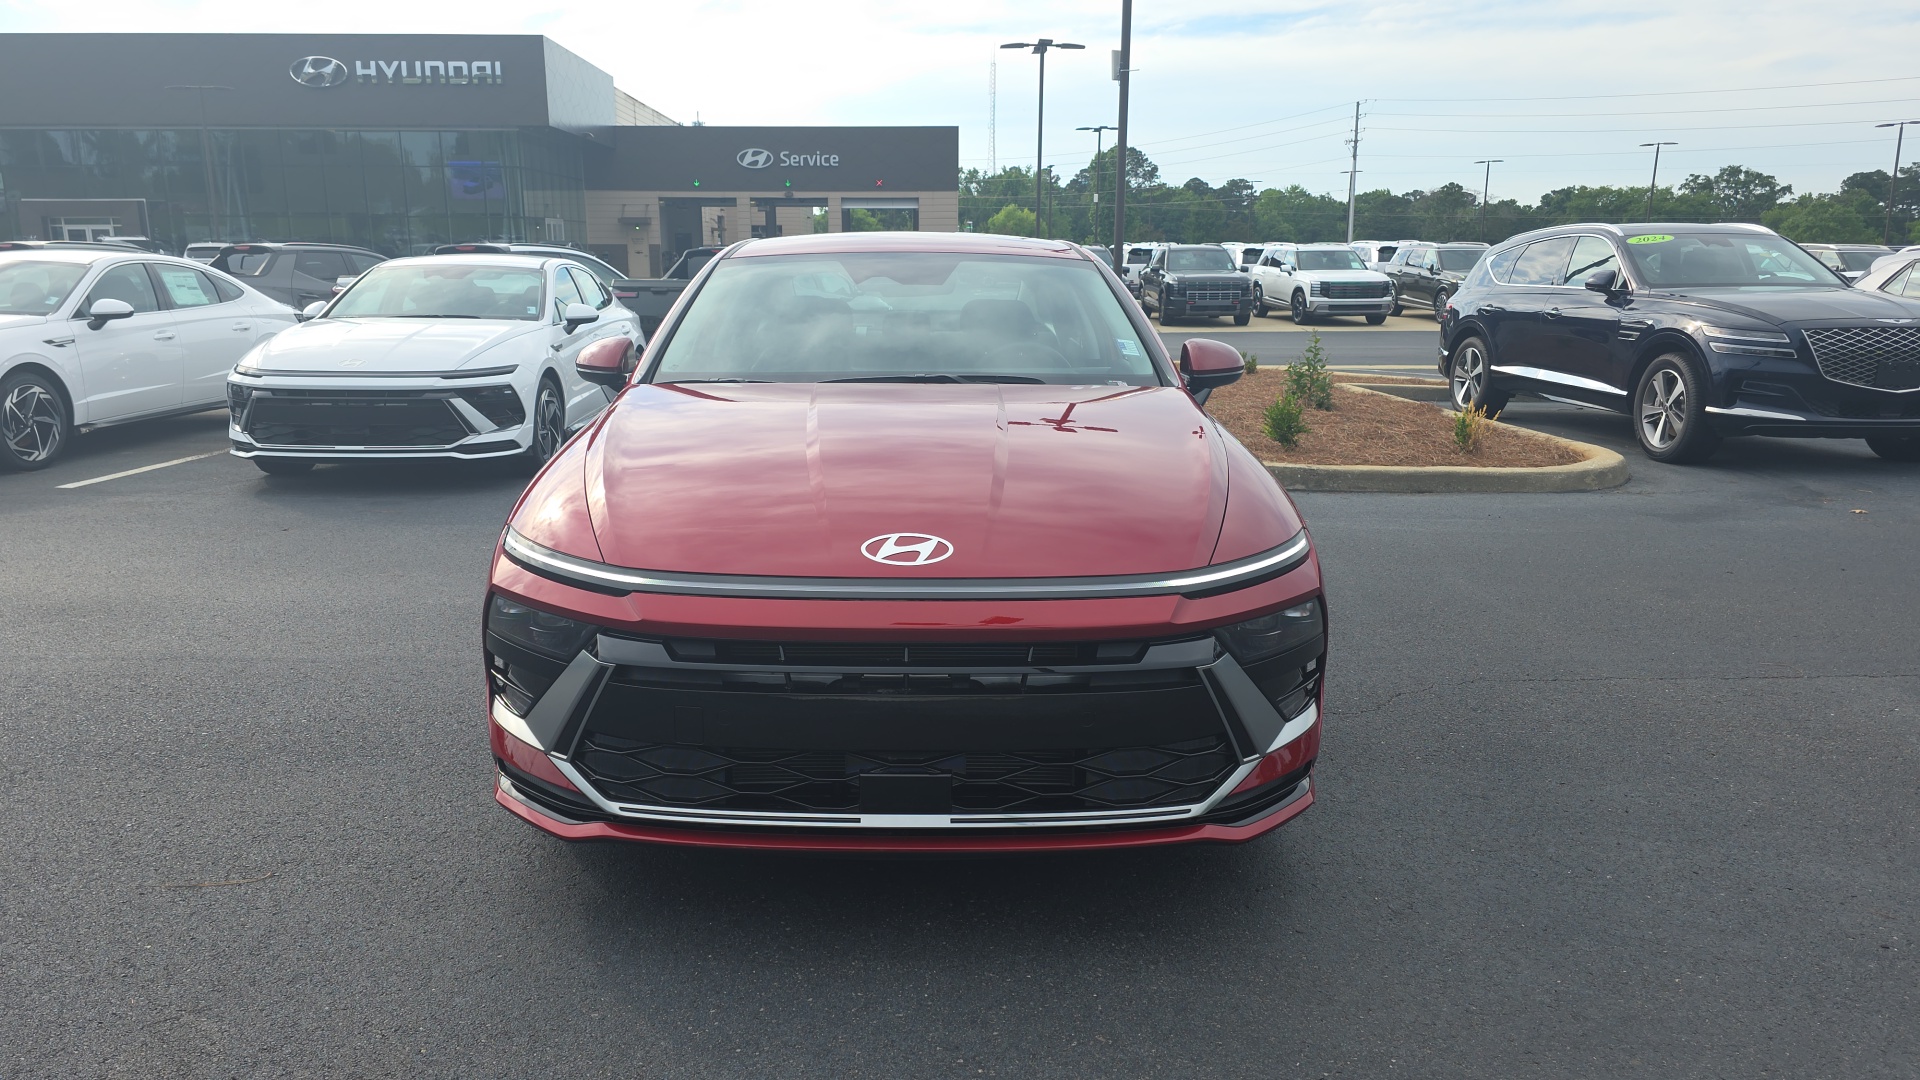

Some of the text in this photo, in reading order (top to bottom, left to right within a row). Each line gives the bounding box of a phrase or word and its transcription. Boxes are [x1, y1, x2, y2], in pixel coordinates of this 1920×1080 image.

[355, 60, 503, 84] HYUNDAI
[780, 151, 839, 167] Service
[1635, 235, 1666, 243] 2024
